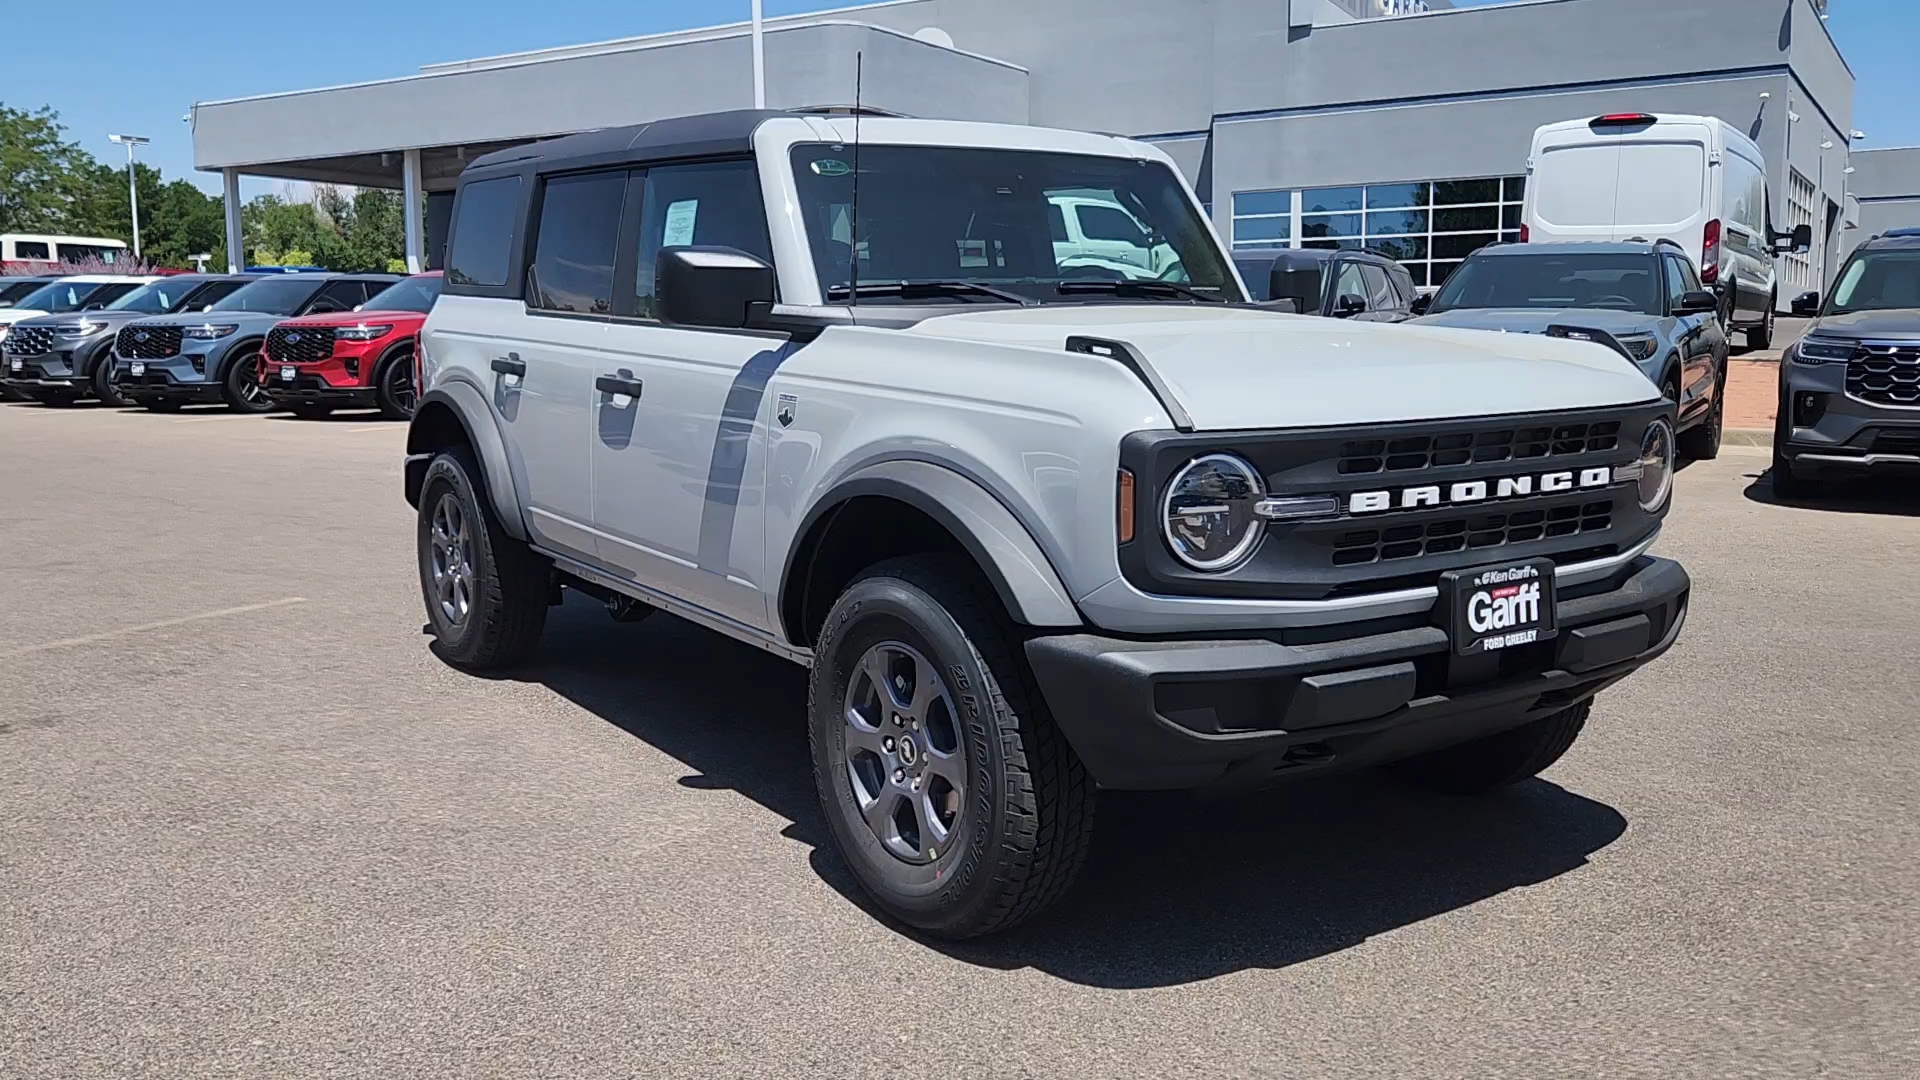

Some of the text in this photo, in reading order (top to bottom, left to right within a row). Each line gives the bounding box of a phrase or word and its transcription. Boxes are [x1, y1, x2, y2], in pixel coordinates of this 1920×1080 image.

[1350, 467, 1610, 513] BRONCO
[1509, 565, 1531, 580] Garff
[1468, 581, 1540, 633] Garff
[1484, 630, 1538, 651] FORD GREELEY
